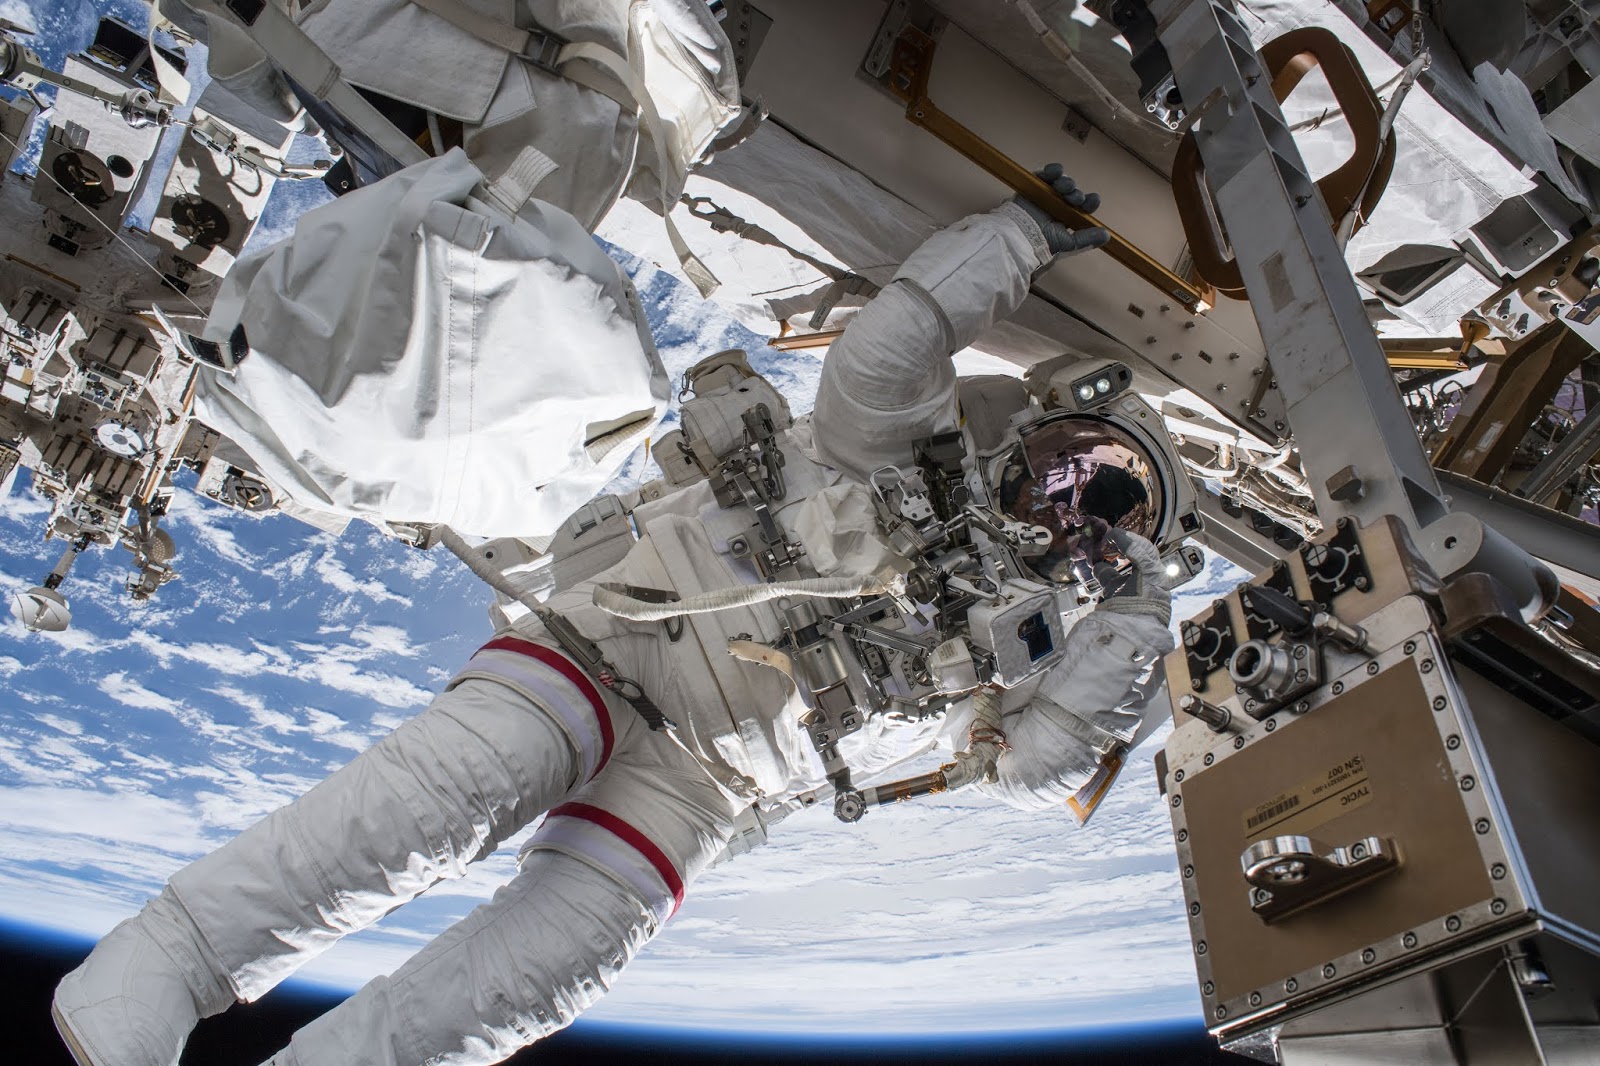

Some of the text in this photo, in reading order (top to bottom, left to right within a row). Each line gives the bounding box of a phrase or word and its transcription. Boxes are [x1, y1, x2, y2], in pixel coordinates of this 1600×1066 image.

[1328, 756, 1361, 779] S/N 007
[1341, 787, 1369, 806] TVCIC
